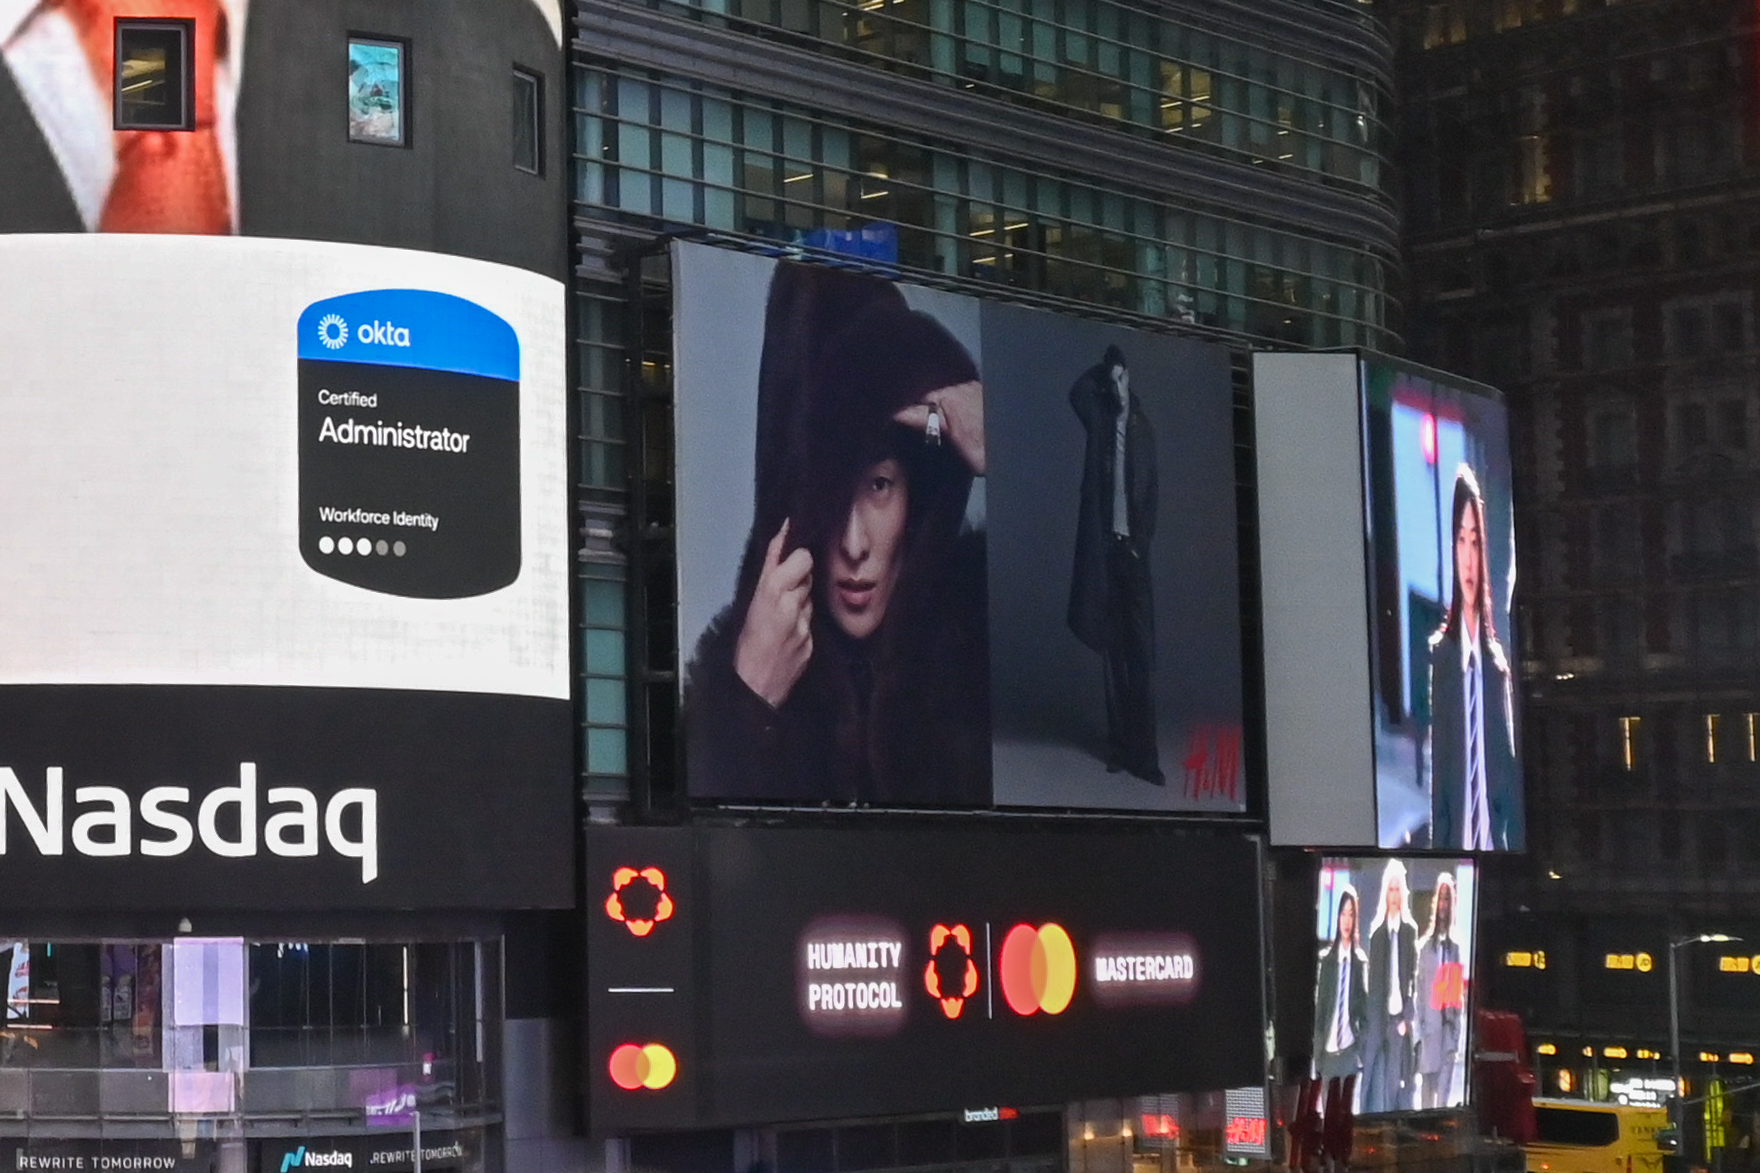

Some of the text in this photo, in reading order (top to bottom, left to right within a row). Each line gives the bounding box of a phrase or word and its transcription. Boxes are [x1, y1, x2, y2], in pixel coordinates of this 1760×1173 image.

[357, 319, 412, 348] okta
[317, 388, 378, 408] Certified
[318, 416, 471, 454] Administrator
[319, 506, 440, 532] Workforce Identity
[806, 940, 903, 970] HUMANITY
[1095, 954, 1194, 982] MASTERCARD
[808, 981, 903, 1011] PROTOCOL
[19, 1156, 84, 1169] REWRITE
[91, 1156, 177, 1170] TOMORROW
[304, 1143, 463, 1168] Nasdaq REWRITE TOMORROW
